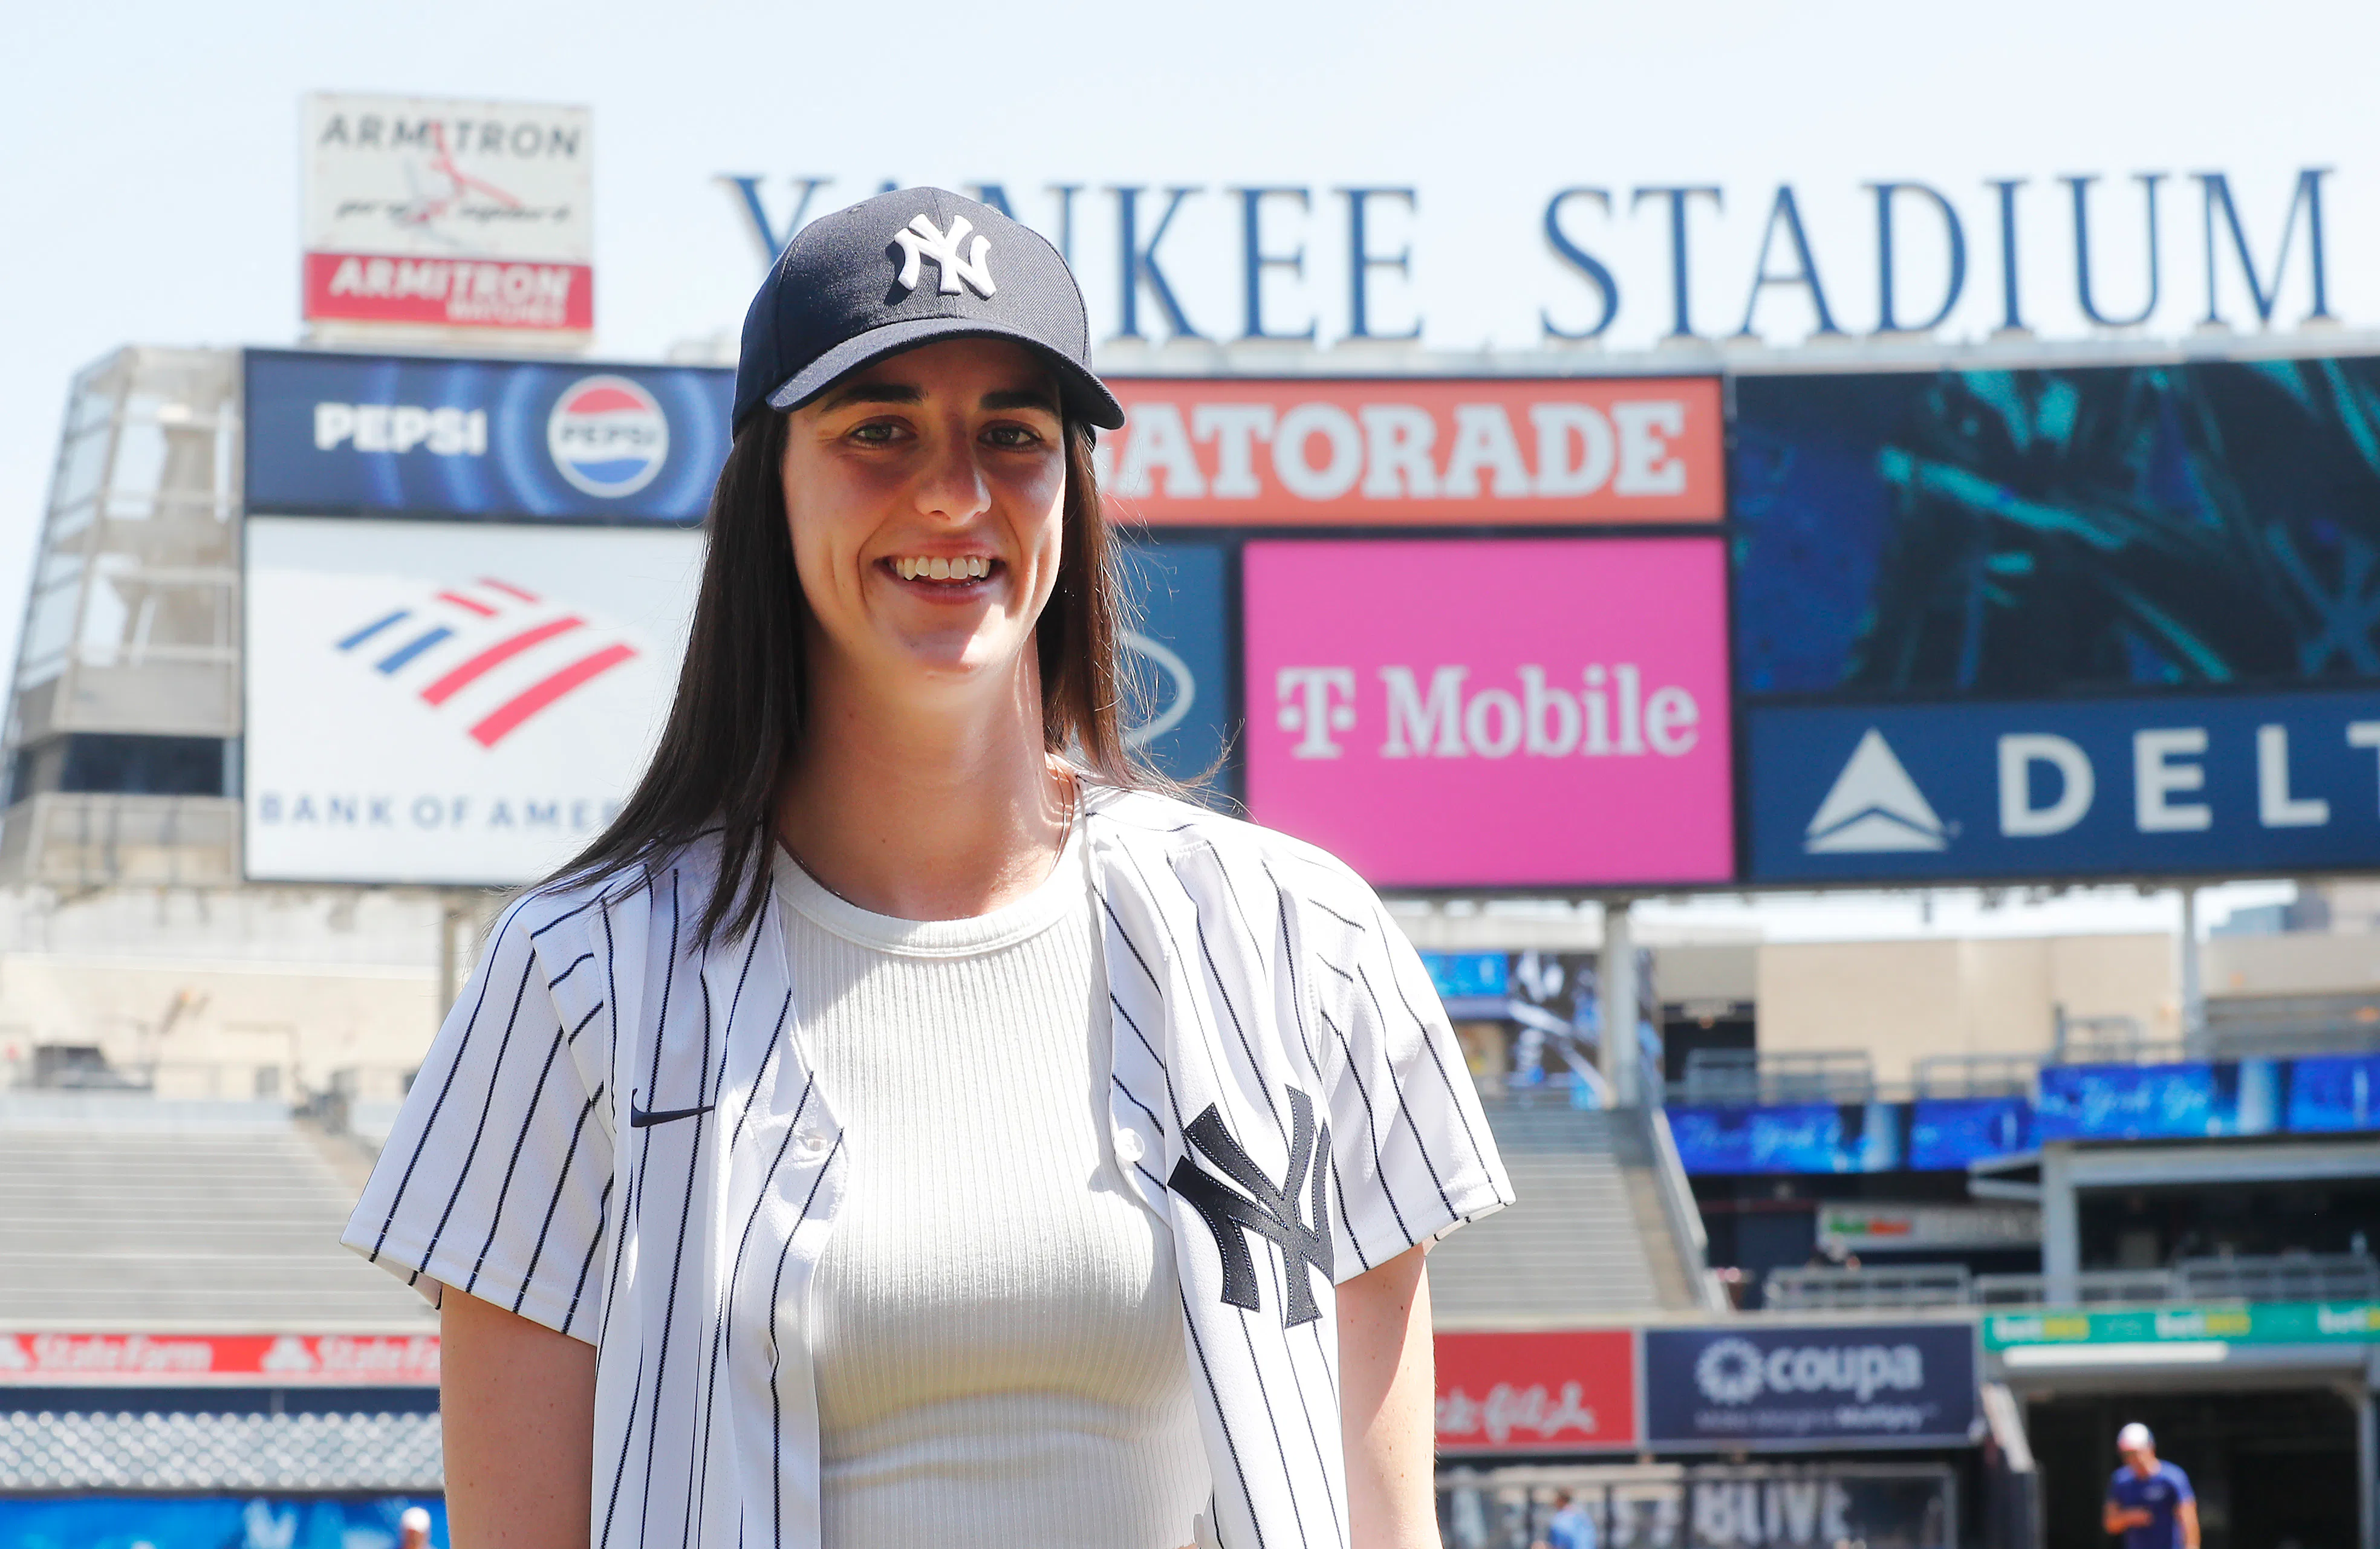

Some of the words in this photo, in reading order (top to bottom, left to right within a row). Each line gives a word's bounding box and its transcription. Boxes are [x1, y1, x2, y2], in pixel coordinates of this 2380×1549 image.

[329, 256, 571, 306] ARMITRON
[714, 175, 1425, 340] YNKEE
[1540, 167, 2336, 339] STADIUM
[894, 213, 997, 300] NY
[313, 403, 486, 455] PEPSI
[561, 418, 658, 447] PEPSI
[1090, 400, 1686, 501] ATORADE
[1380, 663, 1699, 758] Mobile
[259, 793, 394, 826] BANK
[409, 794, 474, 830] OF
[1167, 1083, 1335, 1329] NY
[34, 1333, 123, 1370] State
[123, 1333, 212, 1370] Farm
[317, 1334, 405, 1371] State
[1764, 1342, 1925, 1404] coupa
